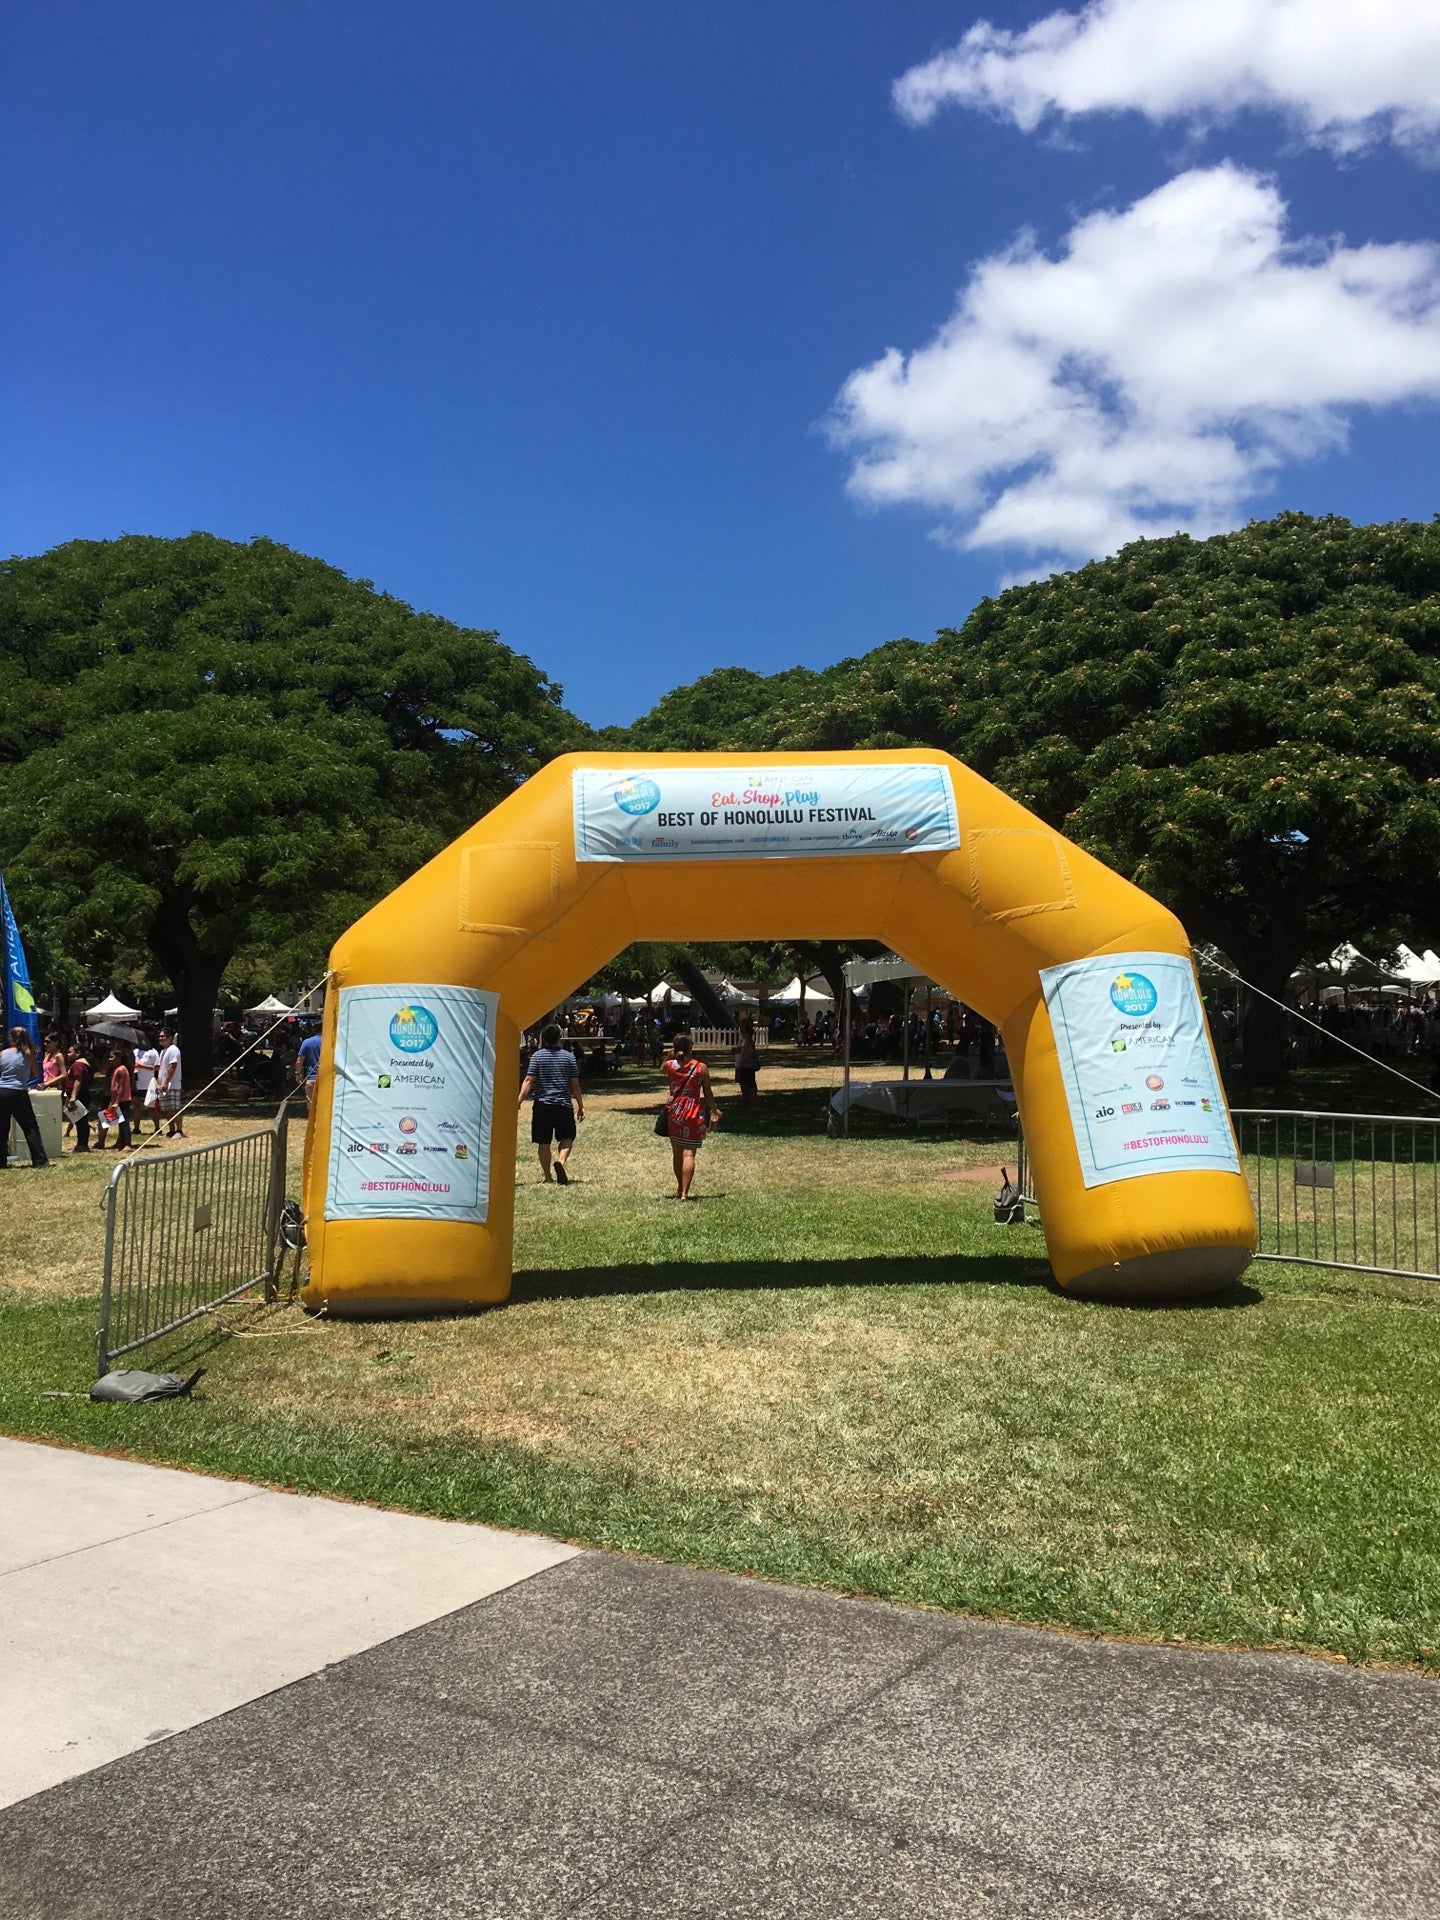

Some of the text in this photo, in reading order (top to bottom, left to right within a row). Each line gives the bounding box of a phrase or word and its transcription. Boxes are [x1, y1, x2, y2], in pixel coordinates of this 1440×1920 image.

[711, 789, 820, 808] Eat, Shop, Play
[628, 802, 651, 813] 2017
[658, 807, 877, 827] BEST OF HONOLULU FESTIVAL
[651, 838, 680, 850] family
[1125, 1003, 1148, 1012] 2017
[1120, 1020, 1161, 1031] Presented by
[399, 1039, 425, 1049] 2017
[390, 1058, 434, 1069] Presented by
[393, 1075, 446, 1085] AMERICAN
[1095, 1106, 1115, 1119] aio
[347, 1141, 364, 1153] aio
[1123, 1134, 1209, 1151] #BESTOFHONOLULU
[360, 1181, 451, 1193] #BESTOFHONOLULU
